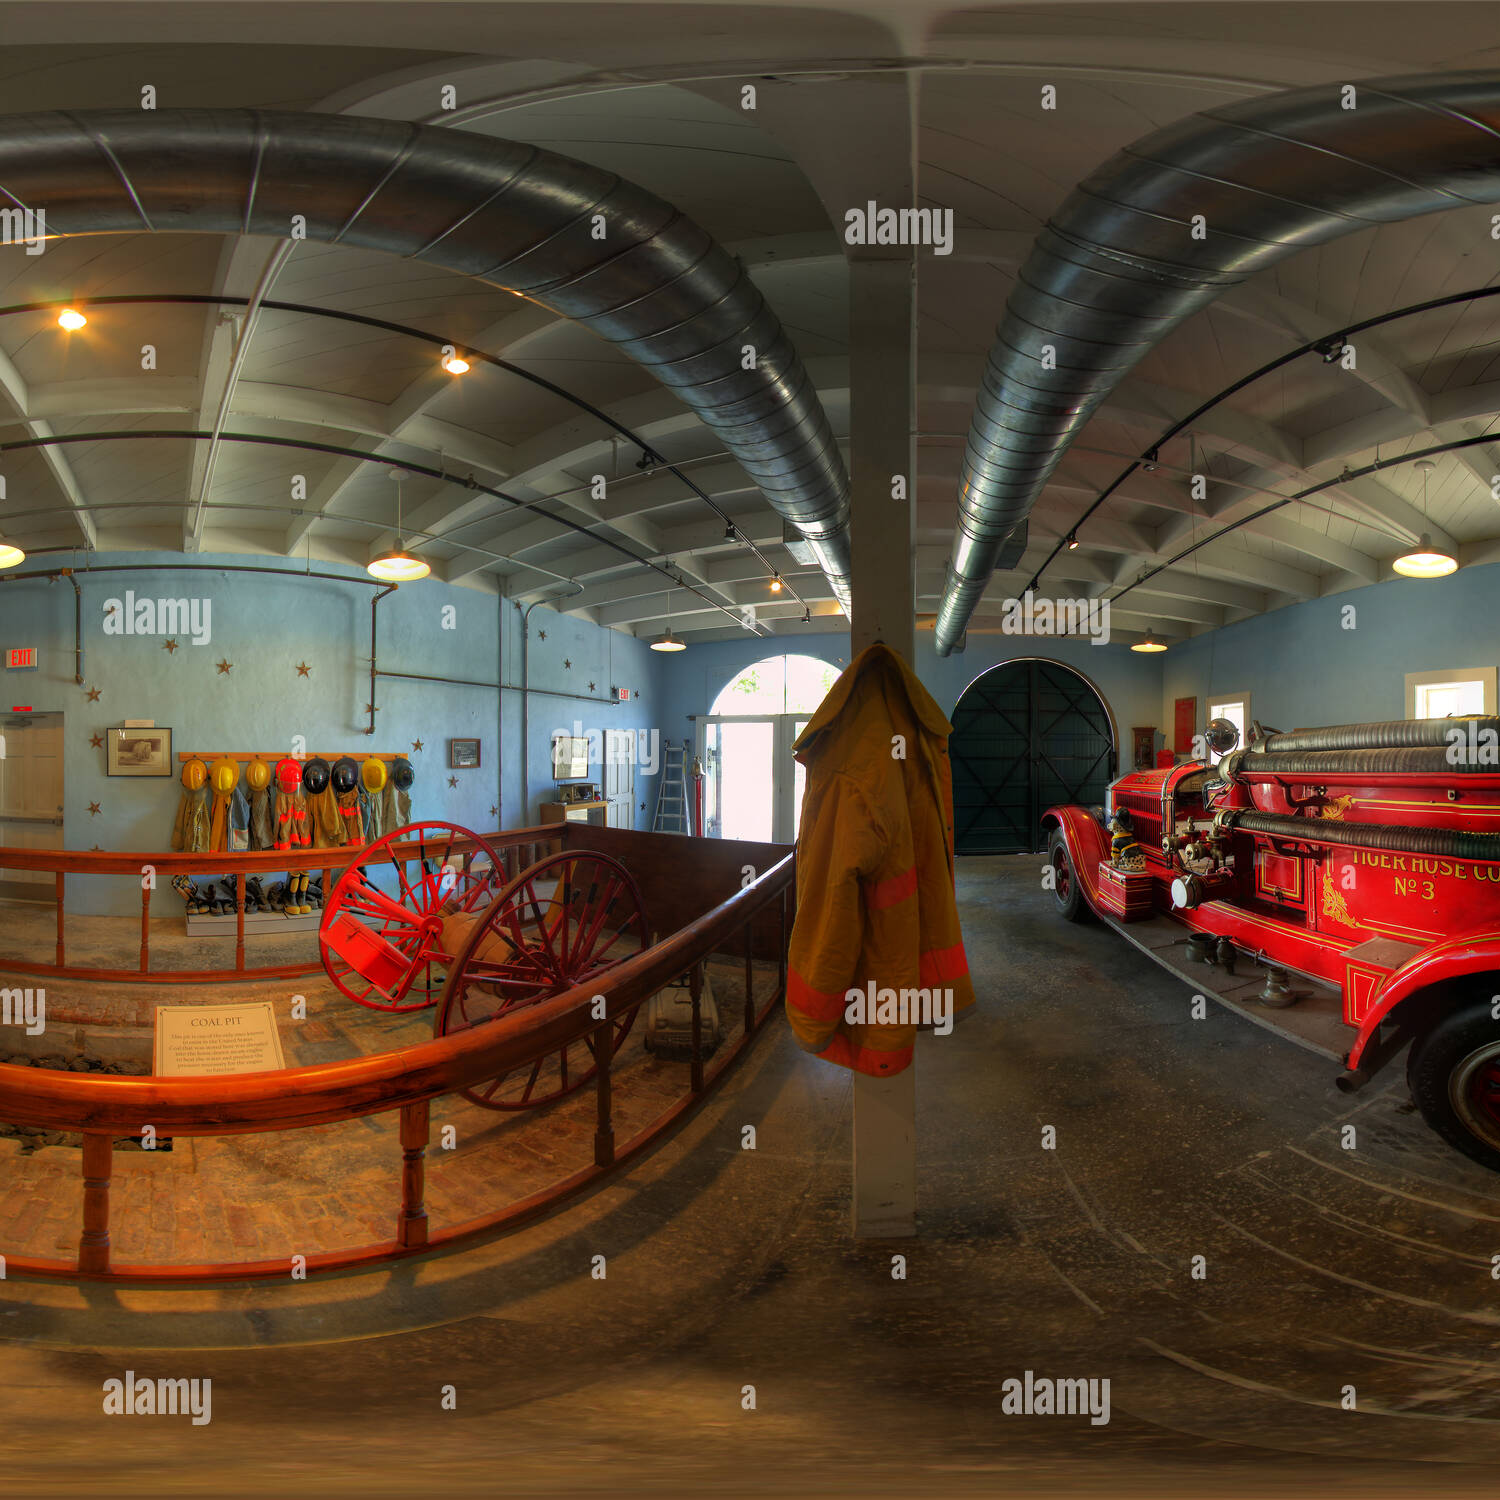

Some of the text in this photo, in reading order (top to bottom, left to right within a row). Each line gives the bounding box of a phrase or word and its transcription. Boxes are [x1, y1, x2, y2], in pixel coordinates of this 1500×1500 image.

[11, 648, 32, 666] EXIT
[1353, 850, 1407, 871] TIGER
[1411, 857, 1467, 880] HOSE
[1422, 880, 1435, 900] 3
[191, 1017, 243, 1027] COAL PIT
